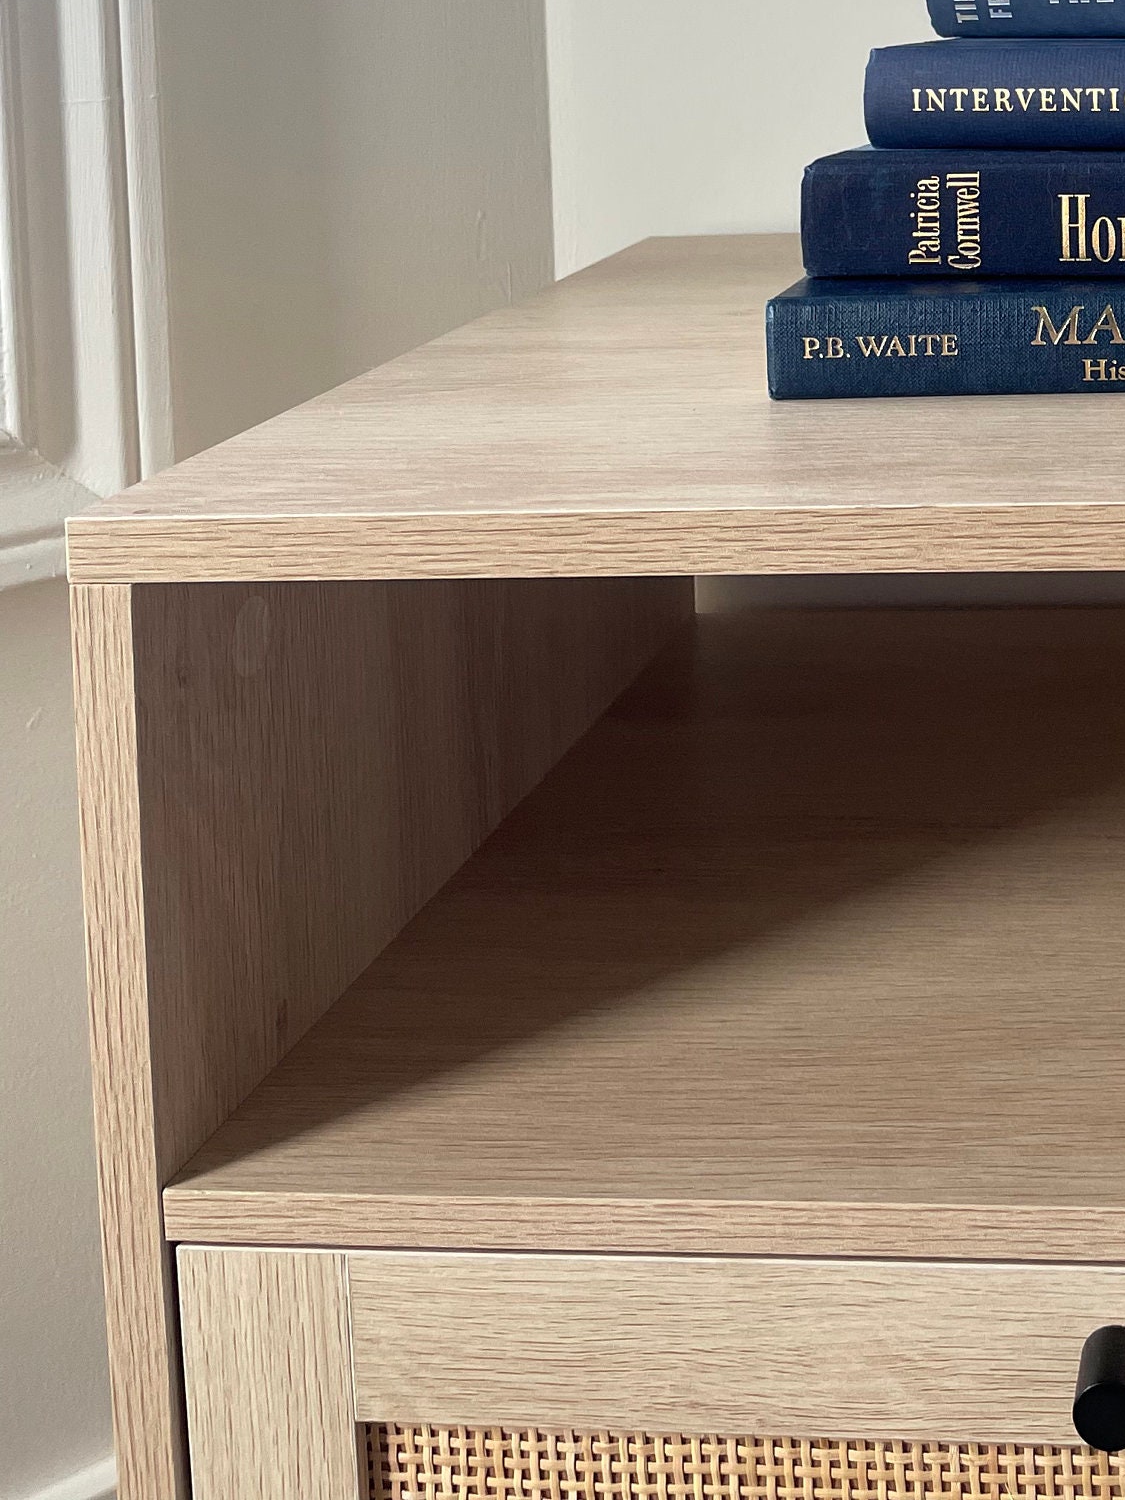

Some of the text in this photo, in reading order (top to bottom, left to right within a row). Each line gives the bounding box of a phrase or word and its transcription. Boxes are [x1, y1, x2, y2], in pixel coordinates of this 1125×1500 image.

[909, 176, 941, 264] Patricia
[946, 171, 981, 269] Cornwell
[802, 335, 958, 358] P.B. WAITE
